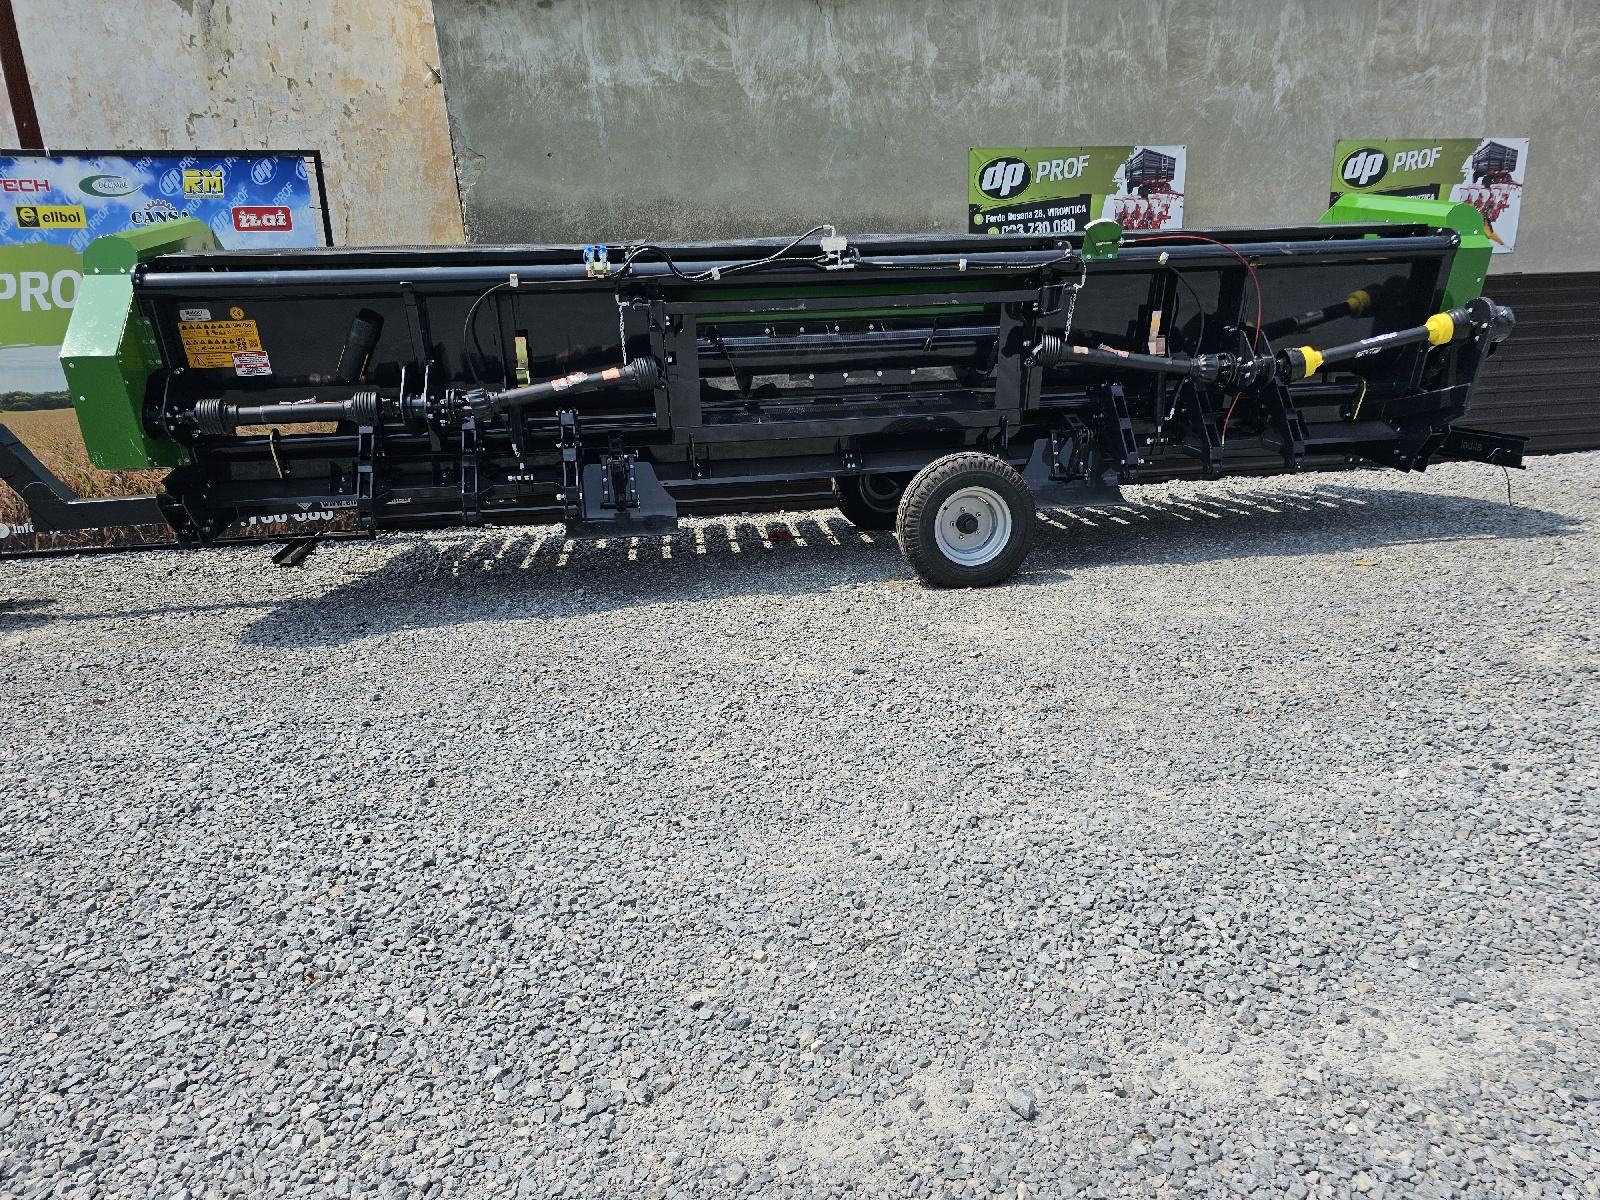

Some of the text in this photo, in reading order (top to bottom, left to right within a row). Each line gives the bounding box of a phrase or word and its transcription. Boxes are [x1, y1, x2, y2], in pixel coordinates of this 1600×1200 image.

[981, 154, 1091, 196] dp PROF
[1343, 146, 1443, 185] dp PROF
[42, 211, 81, 223] elibol
[1034, 209, 1046, 219] 28,
